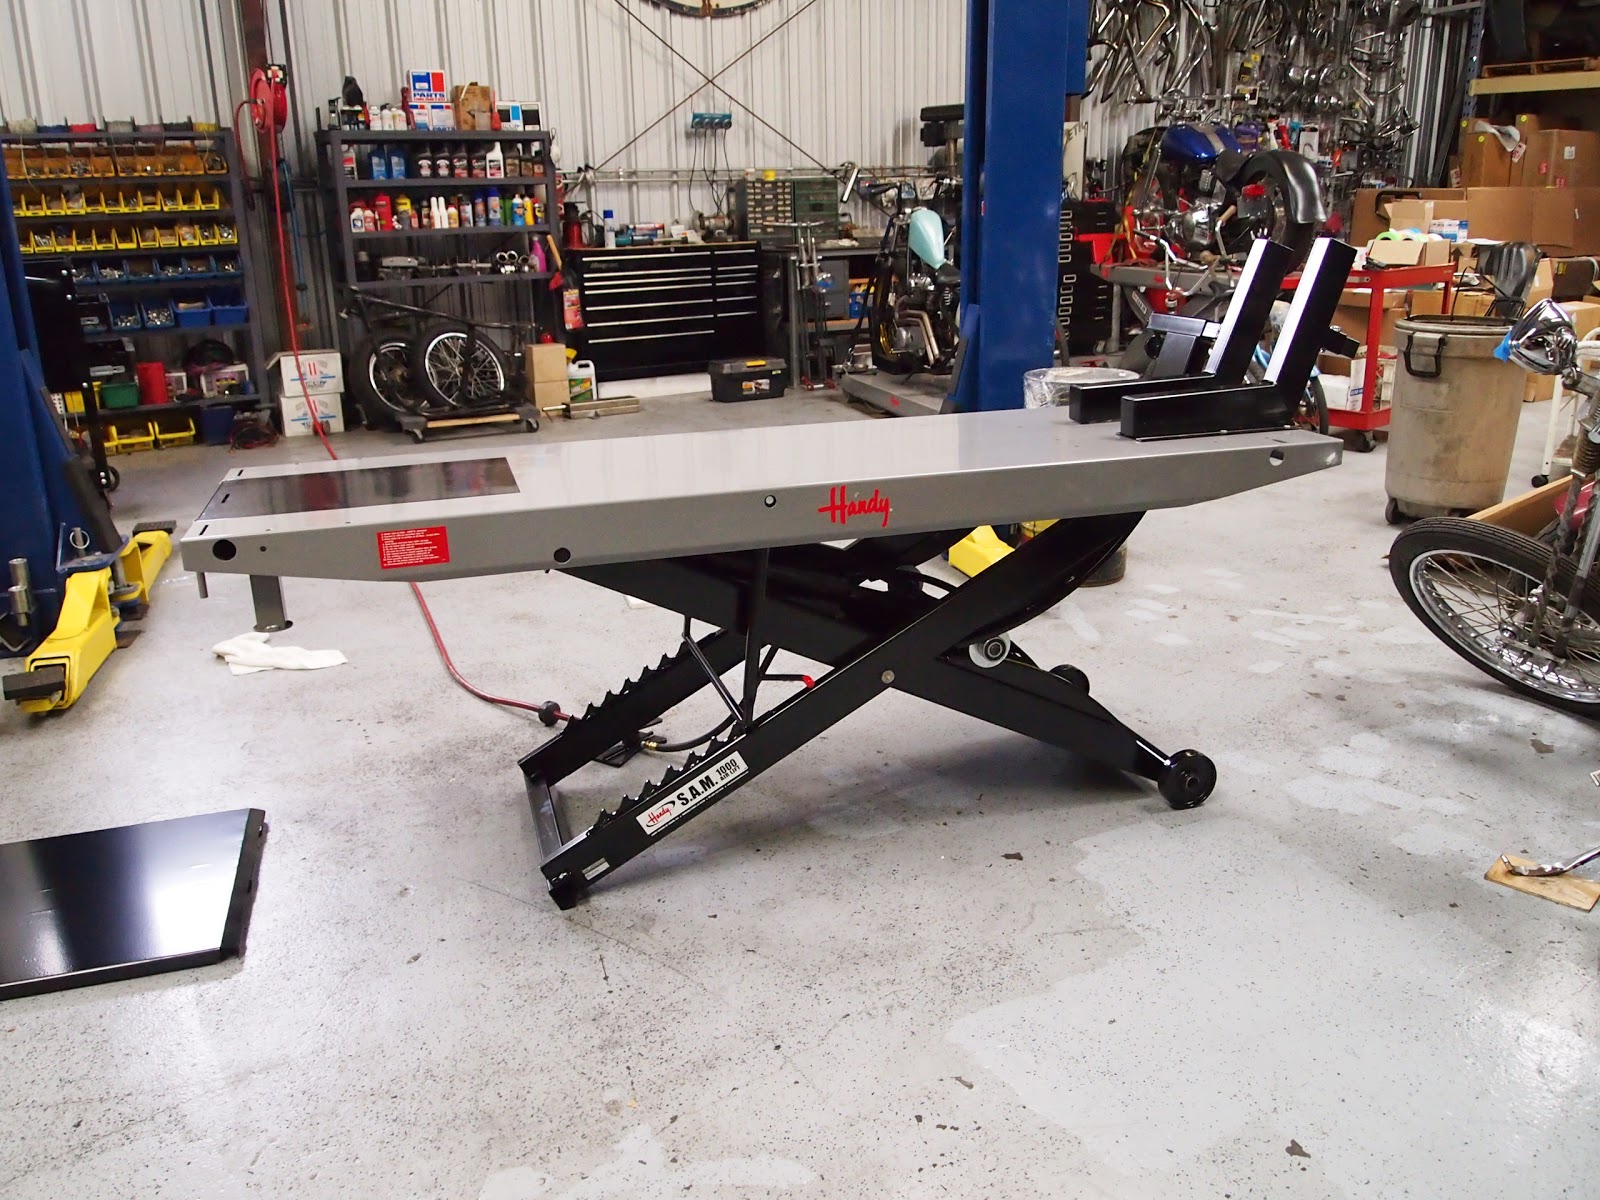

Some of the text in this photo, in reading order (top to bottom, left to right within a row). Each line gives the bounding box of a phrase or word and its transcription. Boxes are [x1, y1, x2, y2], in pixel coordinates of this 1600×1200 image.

[817, 485, 890, 528] Handy
[716, 758, 738, 776] 1000
[720, 765, 741, 781] AIR LIFT
[647, 774, 719, 824] Handy S.A.M.
